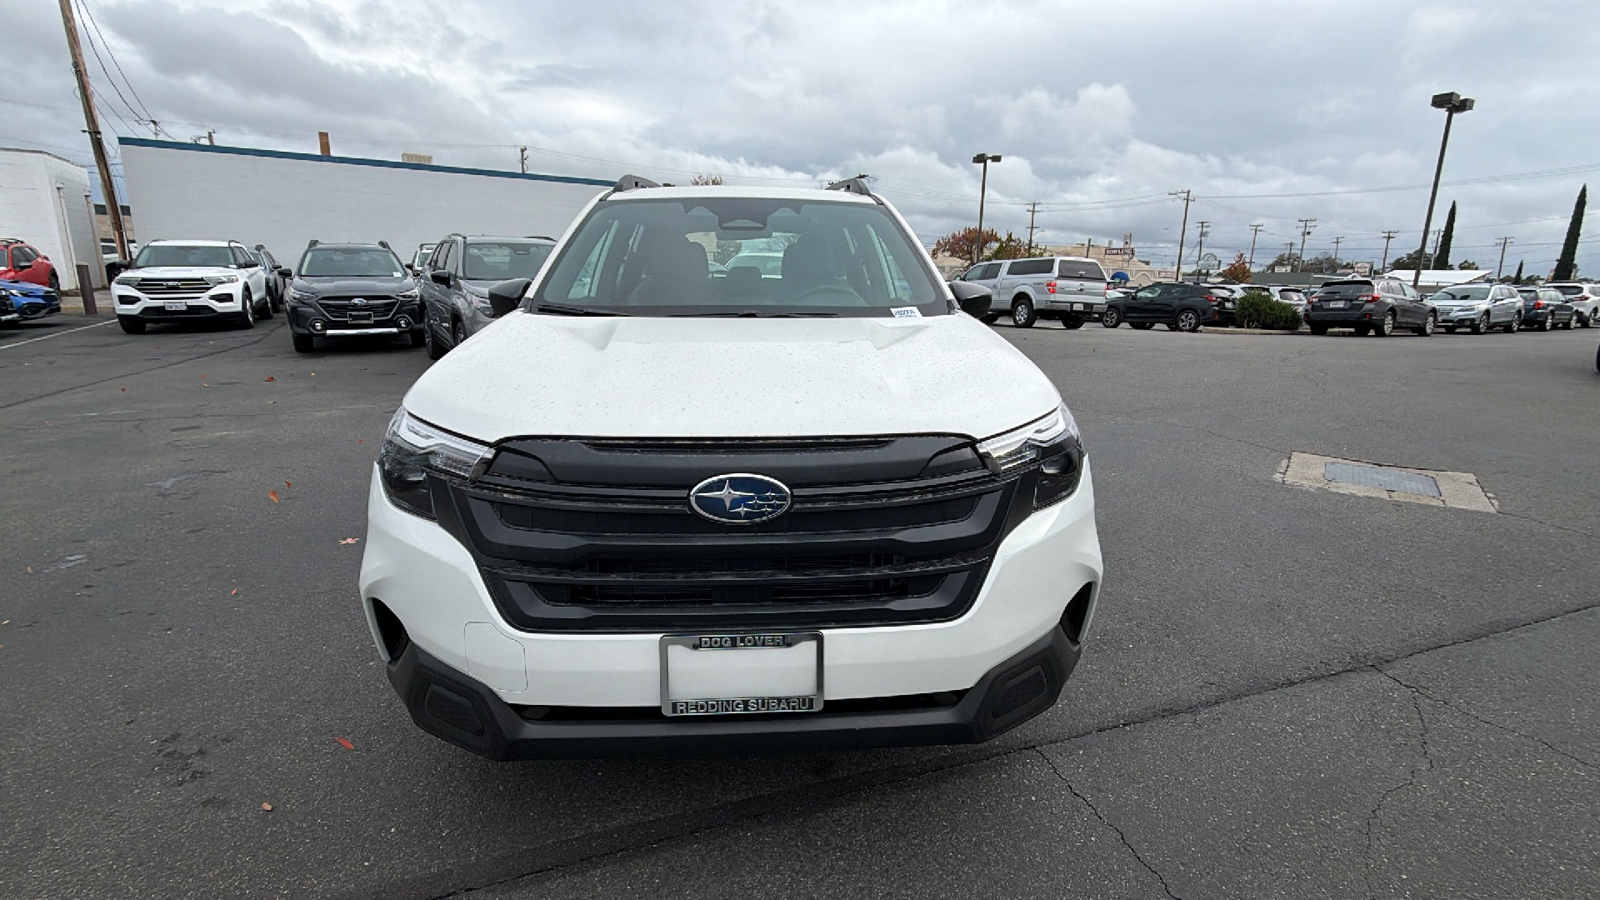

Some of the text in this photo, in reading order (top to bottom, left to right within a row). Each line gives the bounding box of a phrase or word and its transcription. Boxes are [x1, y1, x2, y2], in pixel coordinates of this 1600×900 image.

[701, 636, 784, 648] DOG LOVER
[676, 698, 809, 714] REDDING SUBARU
